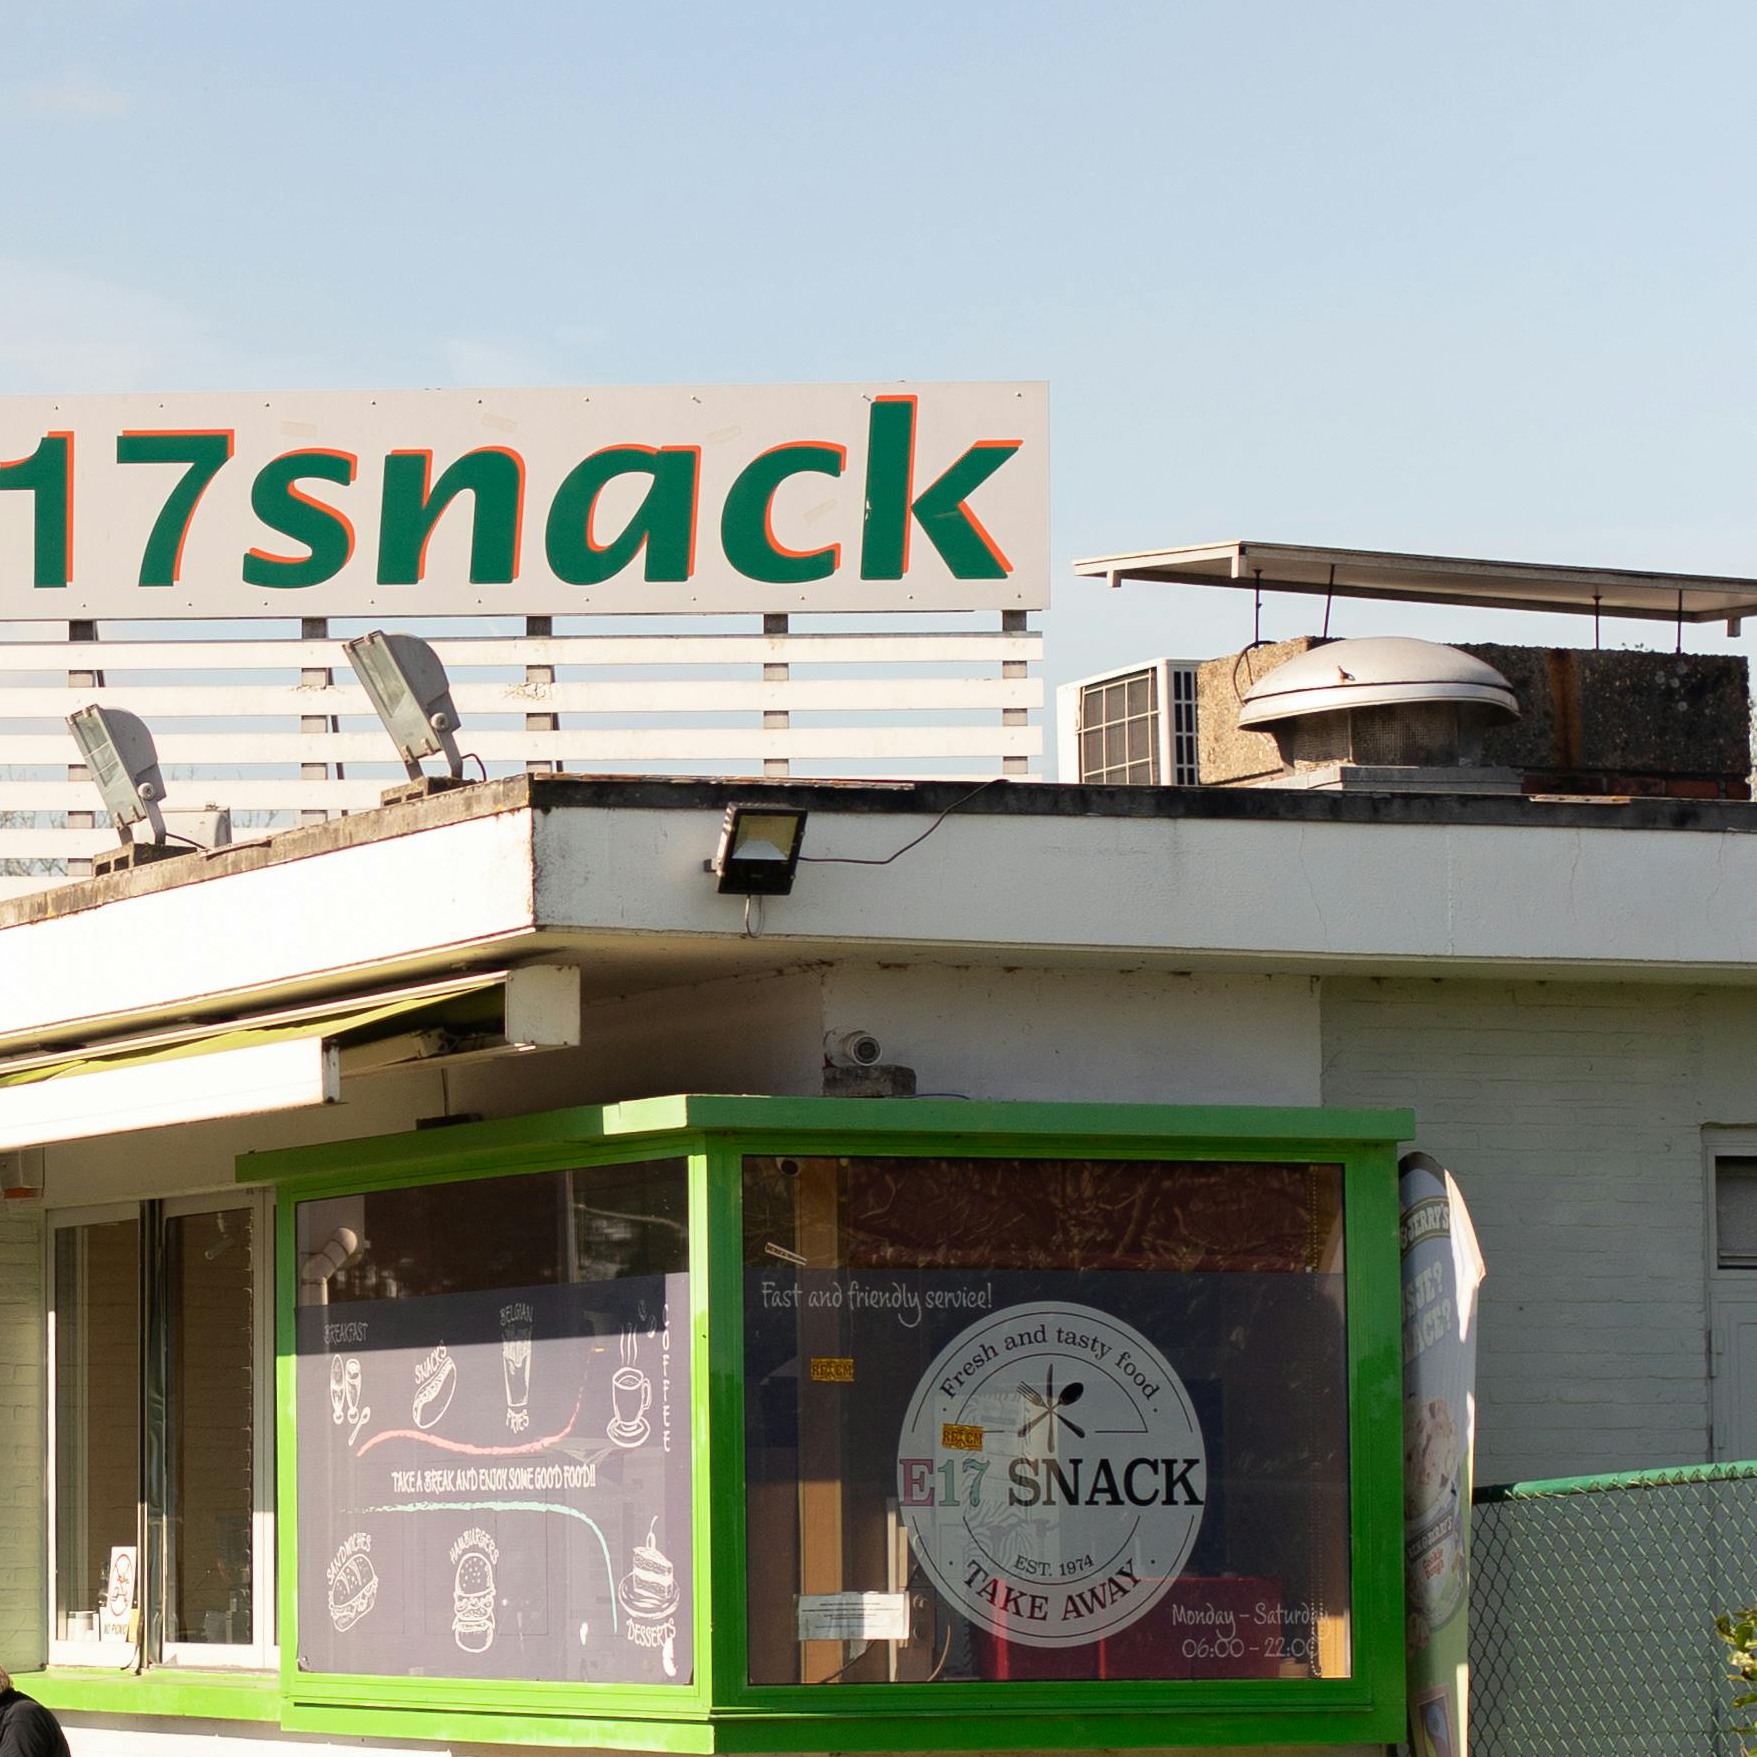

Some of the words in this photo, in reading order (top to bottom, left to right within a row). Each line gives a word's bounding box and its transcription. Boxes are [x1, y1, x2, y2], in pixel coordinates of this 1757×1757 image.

[762, 1281, 802, 1308] Fast
[808, 1282, 843, 1308] and
[848, 1280, 922, 1328] friendly
[925, 1282, 992, 1309] service!
[324, 1321, 369, 1346] BREAKFAST
[414, 1339, 447, 1384] SNACKS
[662, 1303, 671, 1452] COFFEE
[939, 1342, 999, 1401] Fresh
[1004, 1324, 1047, 1352] and
[1056, 1326, 1112, 1361] tasty
[1114, 1350, 1160, 1402] food
[506, 1407, 530, 1433] FRIES
[392, 1470, 416, 1493] TAKE
[416, 1470, 424, 1490] A
[424, 1468, 456, 1494] BREAK
[455, 1467, 478, 1492] AND
[479, 1467, 508, 1491] ENJOY
[508, 1465, 535, 1490] SOME
[535, 1464, 563, 1490] GOOD
[899, 1458, 990, 1508] E17
[1008, 1457, 1204, 1507] SNACK
[327, 1532, 371, 1585] SANDWICHES
[449, 1527, 499, 1564] HAMBURGERS
[1014, 1554, 1052, 1577] EST.
[1059, 1554, 1094, 1577] 1974
[963, 1559, 1049, 1621] TAKE
[1061, 1558, 1142, 1621] AWAY
[626, 1618, 676, 1646] DESSERTS
[1172, 1603, 1236, 1640] Monday
[1254, 1602, 1332, 1640] Saturday
[1182, 1638, 1245, 1658] 06:00
[1264, 1637, 1321, 1658] 22:00
